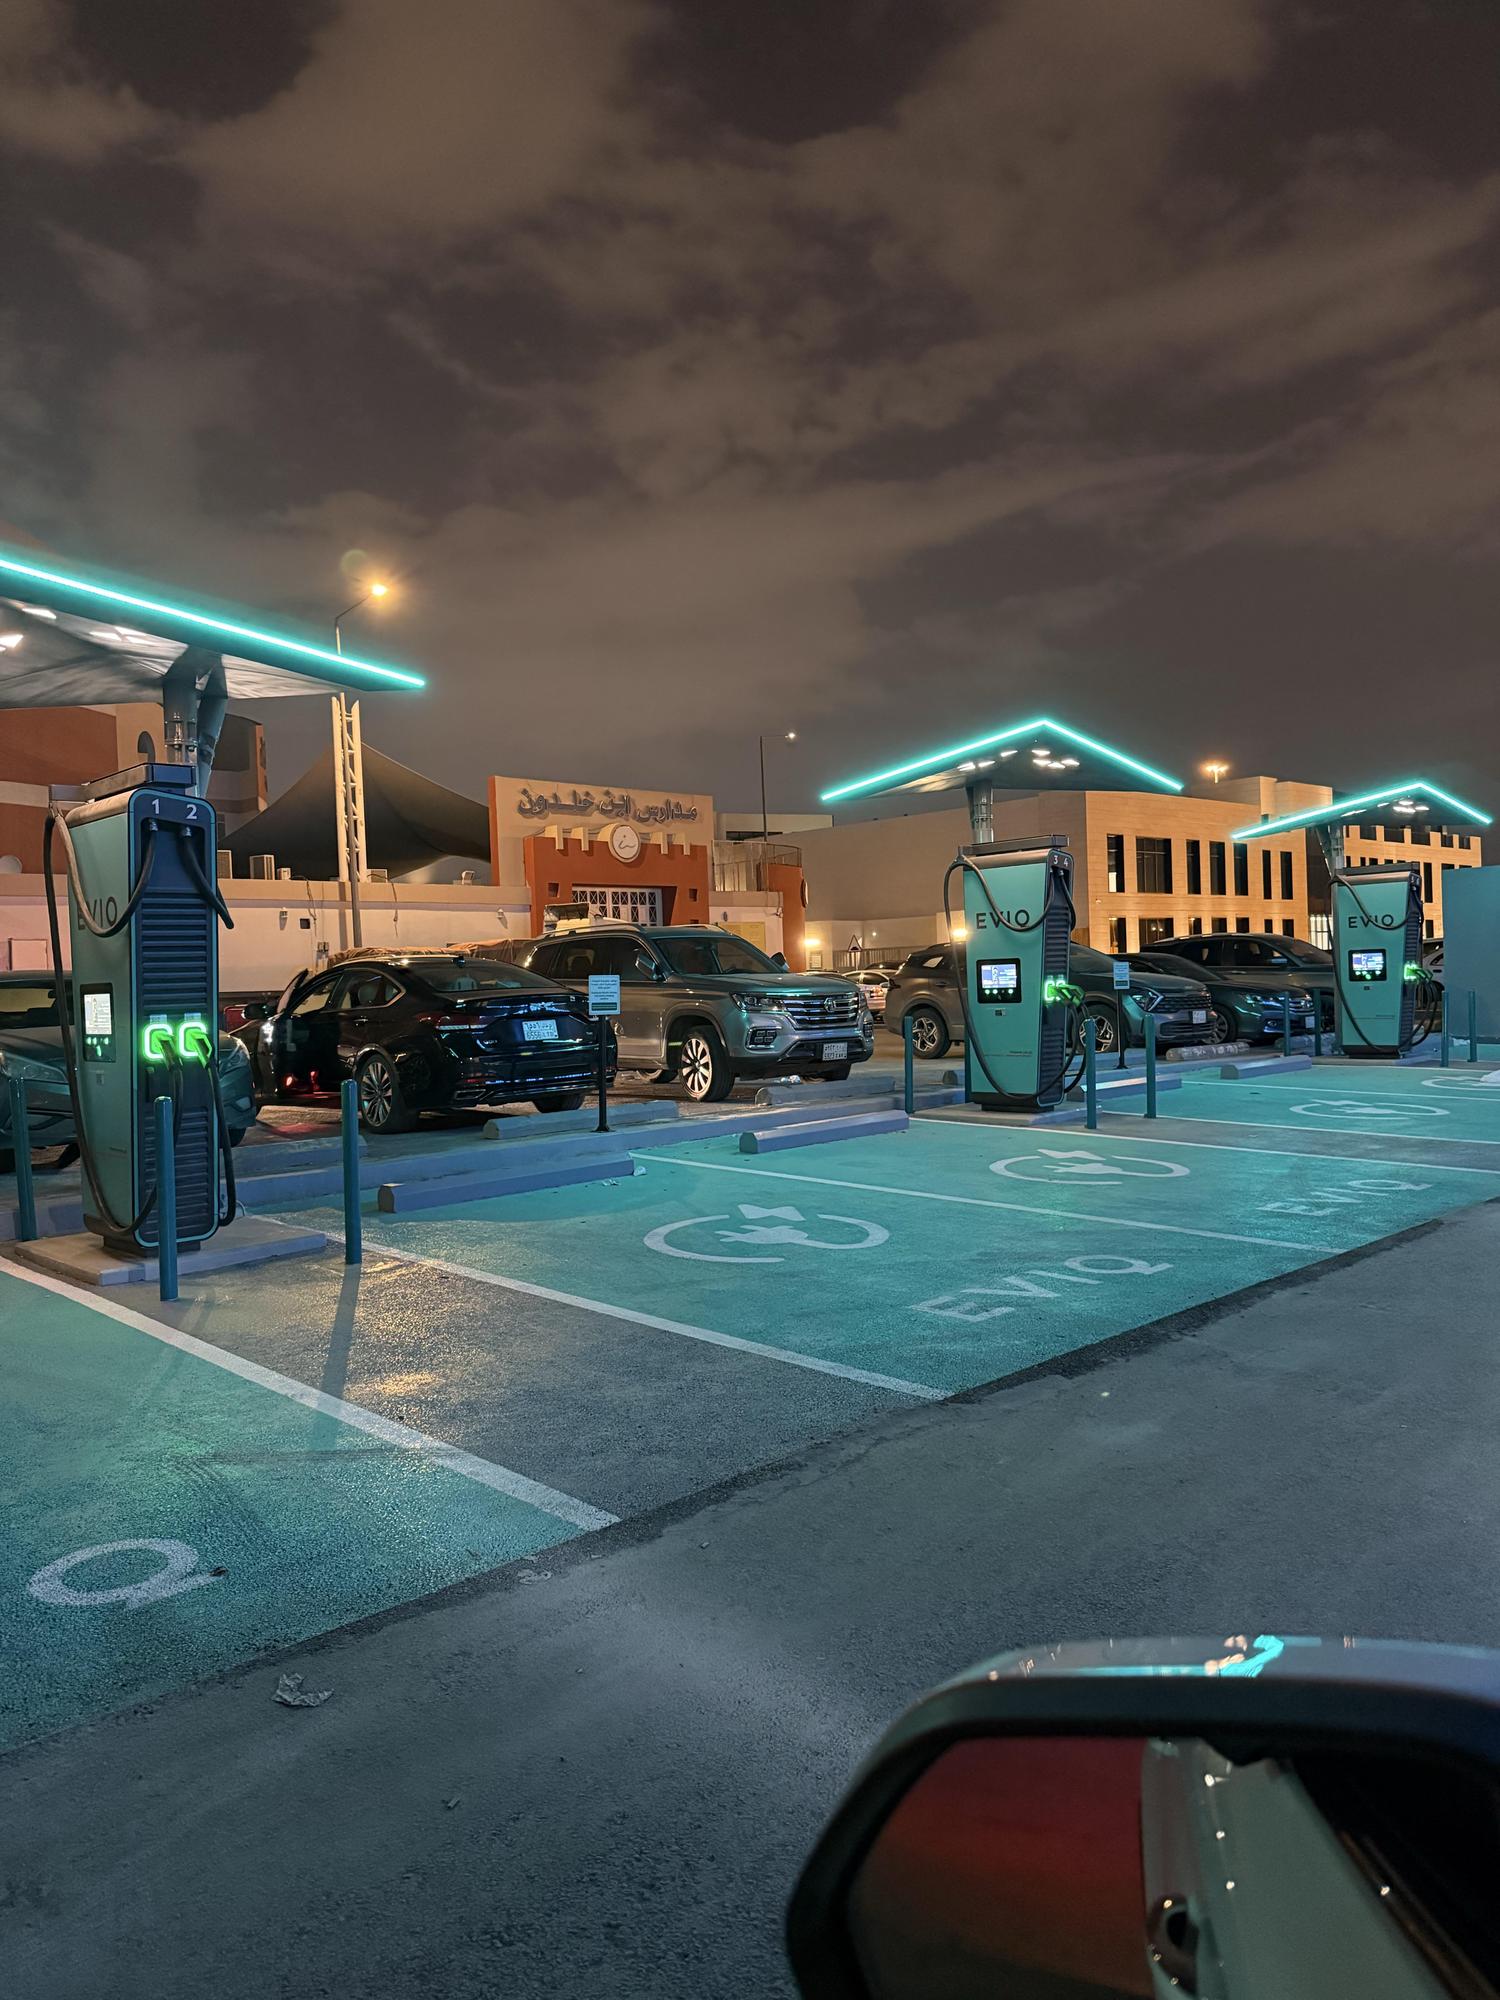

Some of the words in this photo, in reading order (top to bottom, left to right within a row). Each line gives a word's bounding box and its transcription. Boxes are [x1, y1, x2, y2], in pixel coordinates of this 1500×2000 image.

[151, 798, 160, 815] 1
[185, 804, 198, 820] 2
[517, 788, 595, 815] خلدون
[599, 789, 631, 820] ابن
[636, 799, 697, 823] مدارس
[1053, 855, 1058, 865] 3
[1063, 857, 1069, 867] 4
[1255, 1179, 1433, 1217] EVIQ
[908, 1254, 1174, 1323] EVIQ
